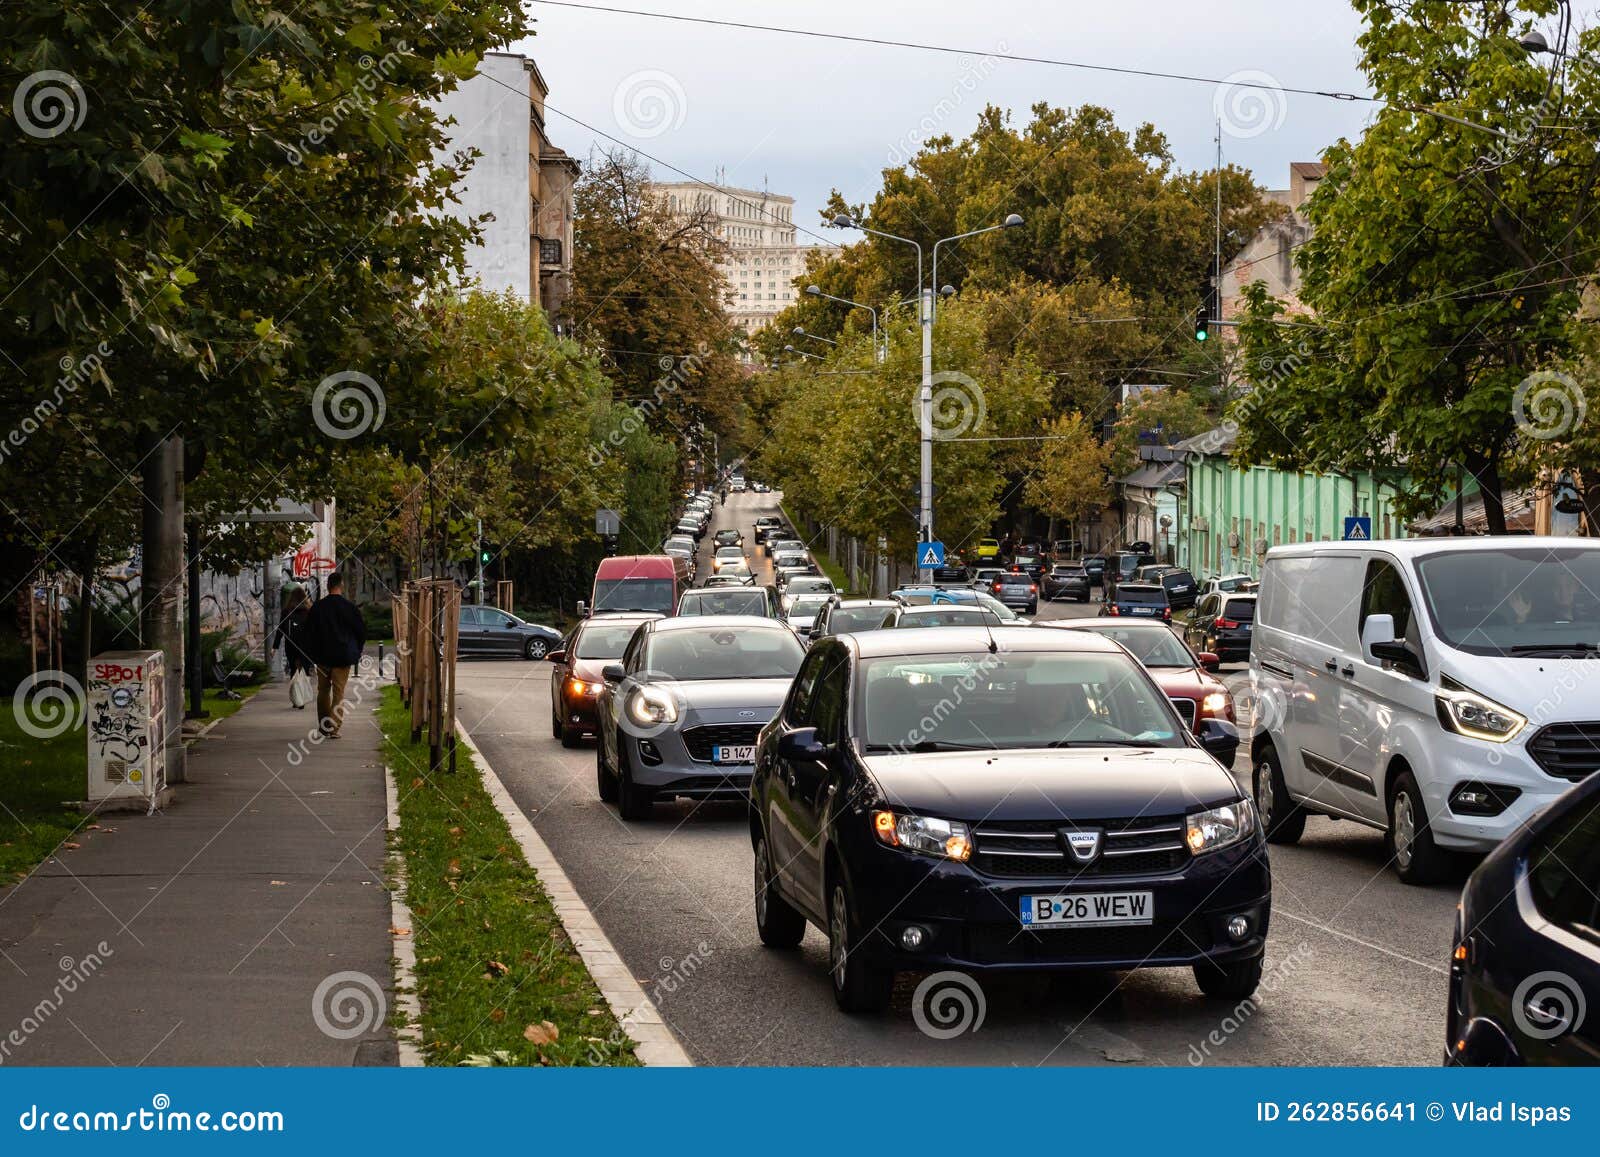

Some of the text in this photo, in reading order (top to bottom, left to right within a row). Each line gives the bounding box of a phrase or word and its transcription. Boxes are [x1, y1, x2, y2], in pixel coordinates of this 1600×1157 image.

[721, 747, 730, 760] B
[734, 747, 752, 759] 147
[1037, 894, 1147, 920] B 26 WEW
[1022, 911, 1032, 921] RO
